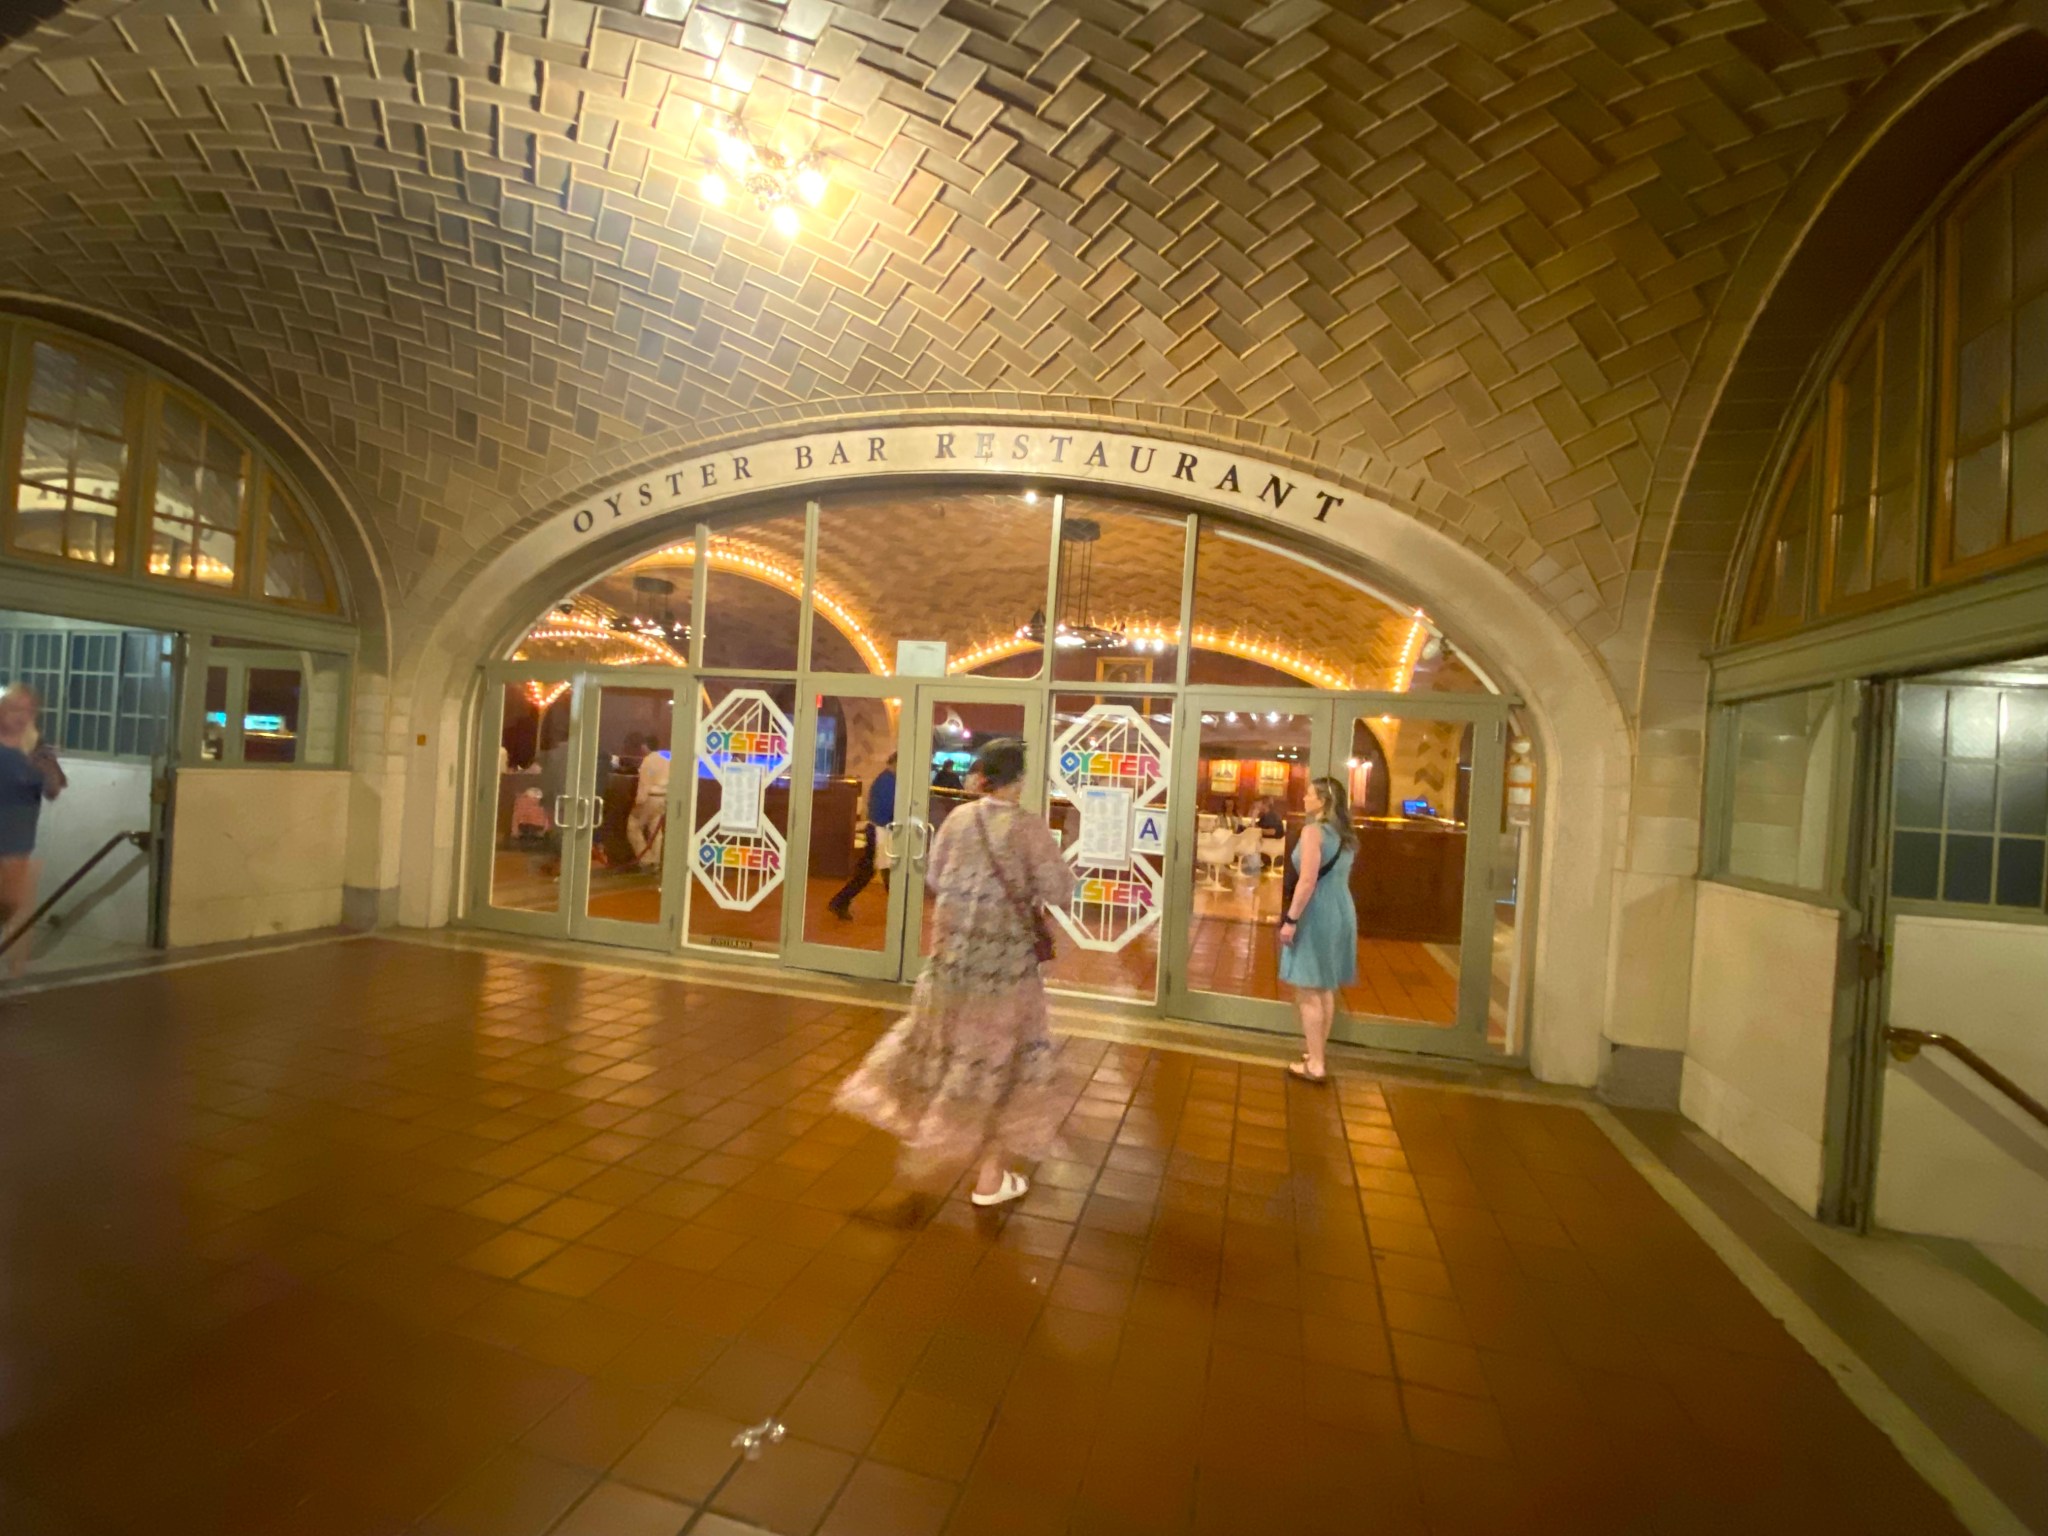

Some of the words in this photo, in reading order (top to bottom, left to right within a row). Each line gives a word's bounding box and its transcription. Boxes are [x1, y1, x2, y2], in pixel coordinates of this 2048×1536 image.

[574, 456, 753, 533] OYSTER
[795, 437, 887, 470] BAR
[933, 433, 1344, 523] RESTAURANT
[706, 730, 789, 755] OYSTER
[1060, 752, 1163, 778] OYSTER
[1139, 817, 1159, 840] A
[699, 844, 781, 869] OYSTER
